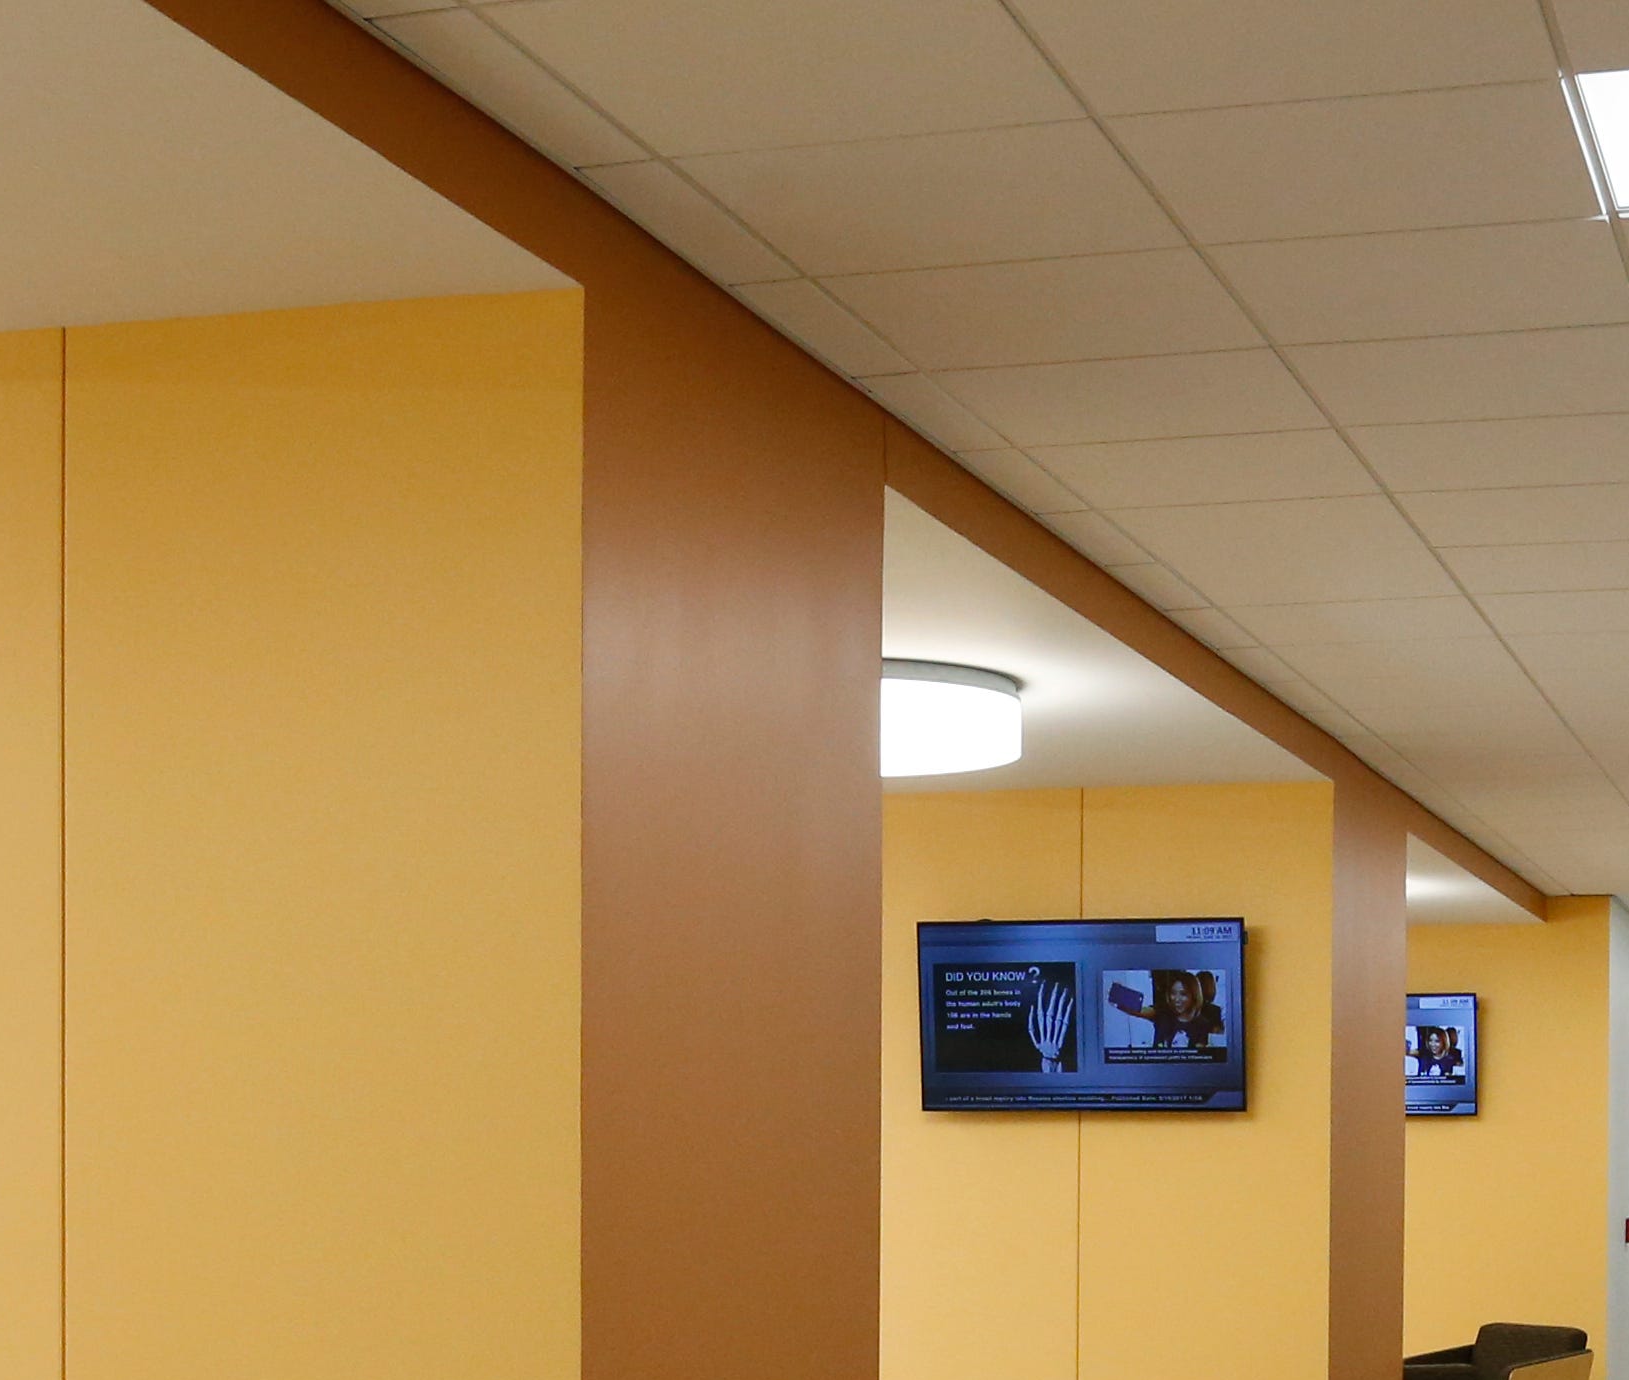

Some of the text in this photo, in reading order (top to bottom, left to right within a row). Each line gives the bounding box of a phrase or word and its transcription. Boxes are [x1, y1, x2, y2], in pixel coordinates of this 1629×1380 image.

[945, 966, 1040, 984] DID YOU KNOW ?
